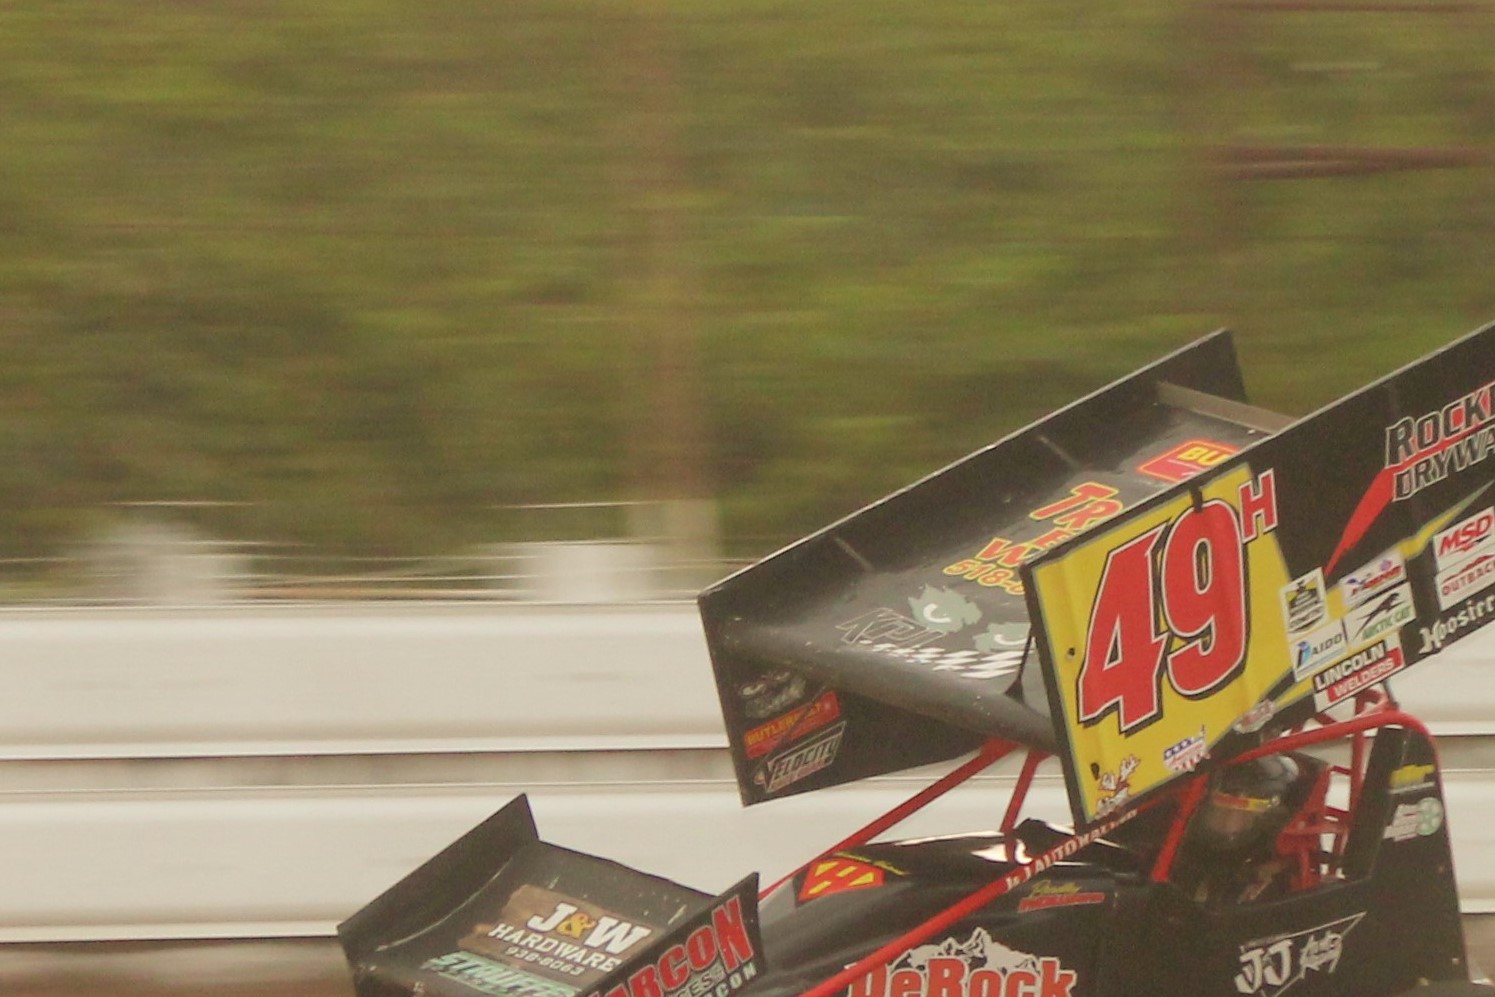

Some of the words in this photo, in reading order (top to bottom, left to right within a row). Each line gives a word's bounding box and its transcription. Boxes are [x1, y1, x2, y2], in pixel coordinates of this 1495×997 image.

[1439, 514, 1493, 557] MSD
[1419, 594, 1495, 655] Hoosier
[1315, 641, 1386, 691] LINCOLN
[1333, 658, 1395, 697] WELDERS
[488, 923, 624, 973] HARDWARE
[526, 902, 653, 956] J&W
